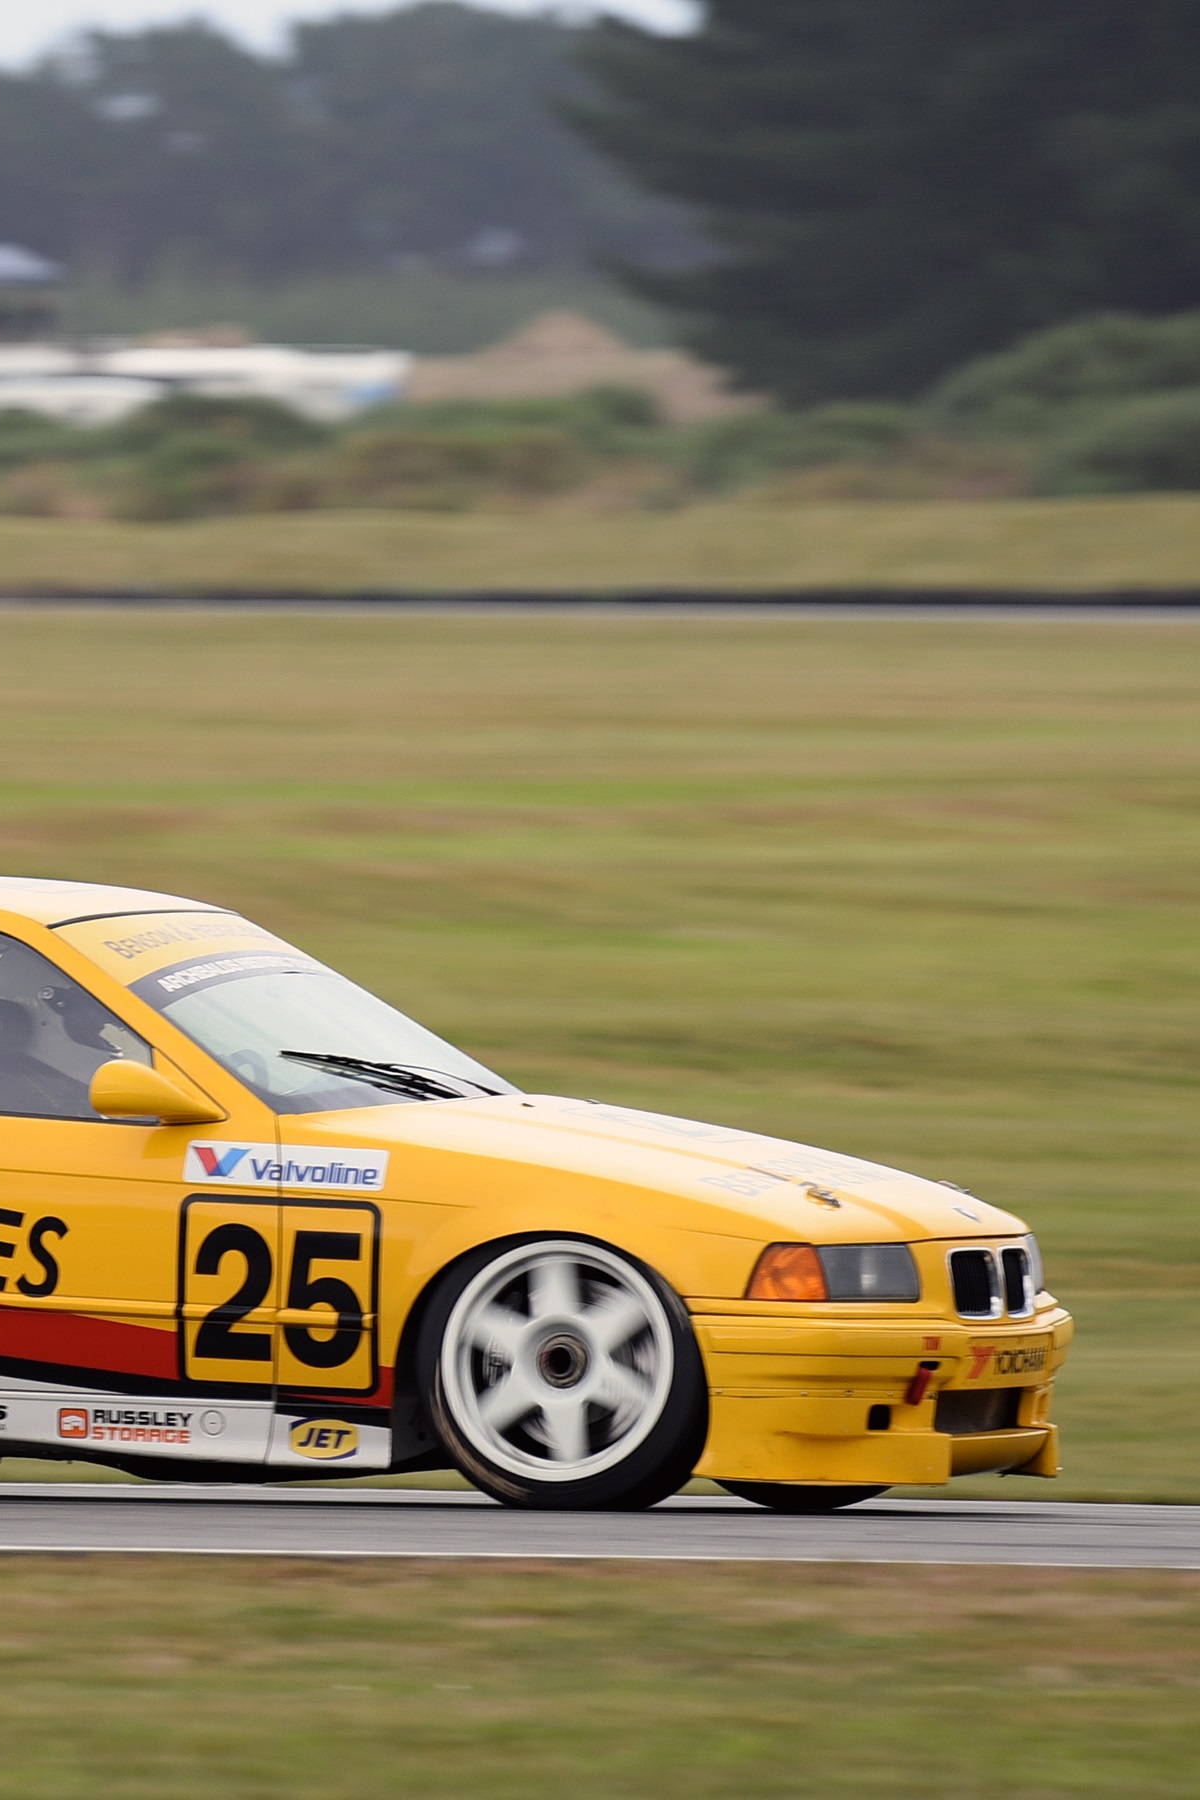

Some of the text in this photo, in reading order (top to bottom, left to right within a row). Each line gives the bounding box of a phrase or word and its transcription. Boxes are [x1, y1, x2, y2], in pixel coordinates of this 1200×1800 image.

[251, 1158, 382, 1185] Valvoline
[193, 1223, 363, 1369] 25
[93, 1408, 192, 1427] RUSSLEY
[91, 1426, 191, 1444] STORAGE
[298, 1427, 353, 1449] JET
